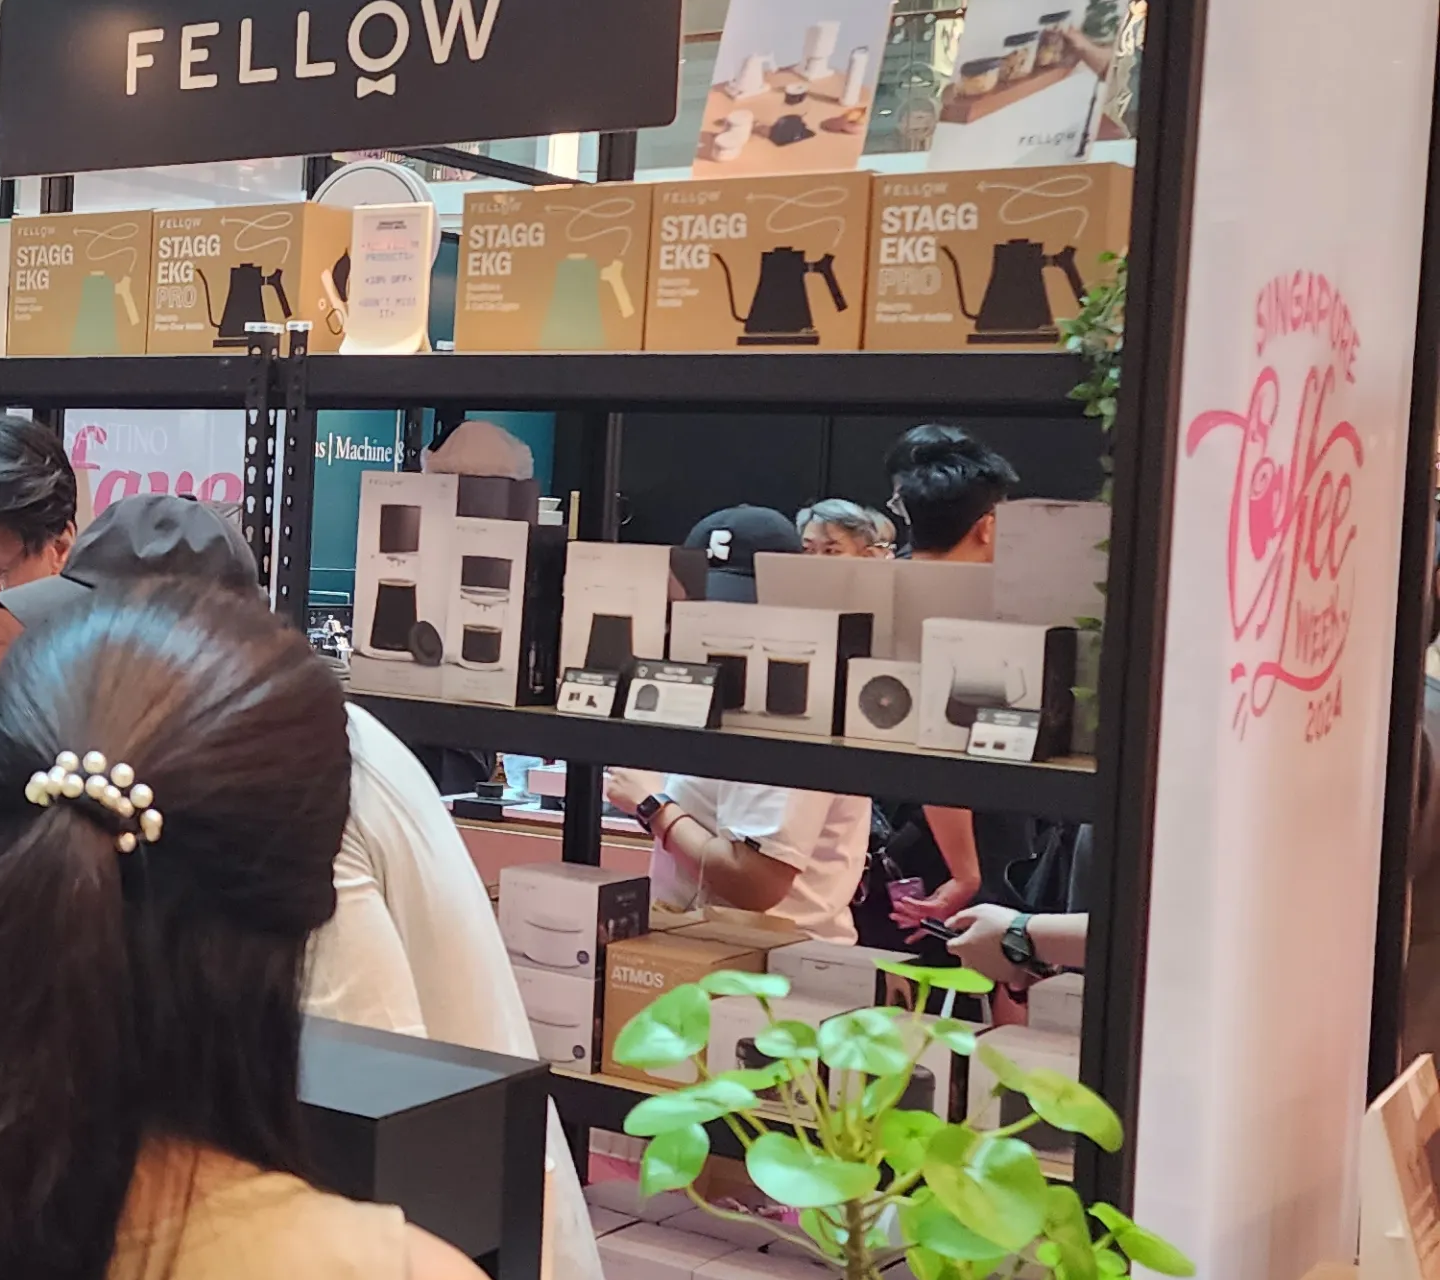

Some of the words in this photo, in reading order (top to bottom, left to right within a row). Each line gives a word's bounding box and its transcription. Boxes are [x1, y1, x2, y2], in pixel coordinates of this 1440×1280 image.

[1018, 130, 1078, 147] FELLOW
[662, 191, 722, 206] FELLOW
[882, 182, 949, 198] FELLOW
[17, 225, 56, 238] FELLOW
[160, 217, 202, 231] FELLOW
[660, 212, 748, 243] STAGG
[881, 202, 979, 235] STAGG
[158, 233, 221, 259] STAGG
[468, 222, 545, 250] STAGG
[17, 244, 74, 268] STAGG
[467, 250, 512, 277] EKG
[659, 243, 710, 271] EKG
[879, 236, 937, 266] EKG
[16, 269, 50, 292] EKG
[157, 261, 195, 284] EKG
[878, 266, 942, 296] PRO
[155, 285, 198, 310] PRO
[1256, 269, 1360, 384] SINGAPORE
[335, 434, 393, 464] Machine
[1294, 584, 1347, 666] WEEK
[1304, 674, 1344, 744] 2024
[611, 964, 665, 989] ATMOS
